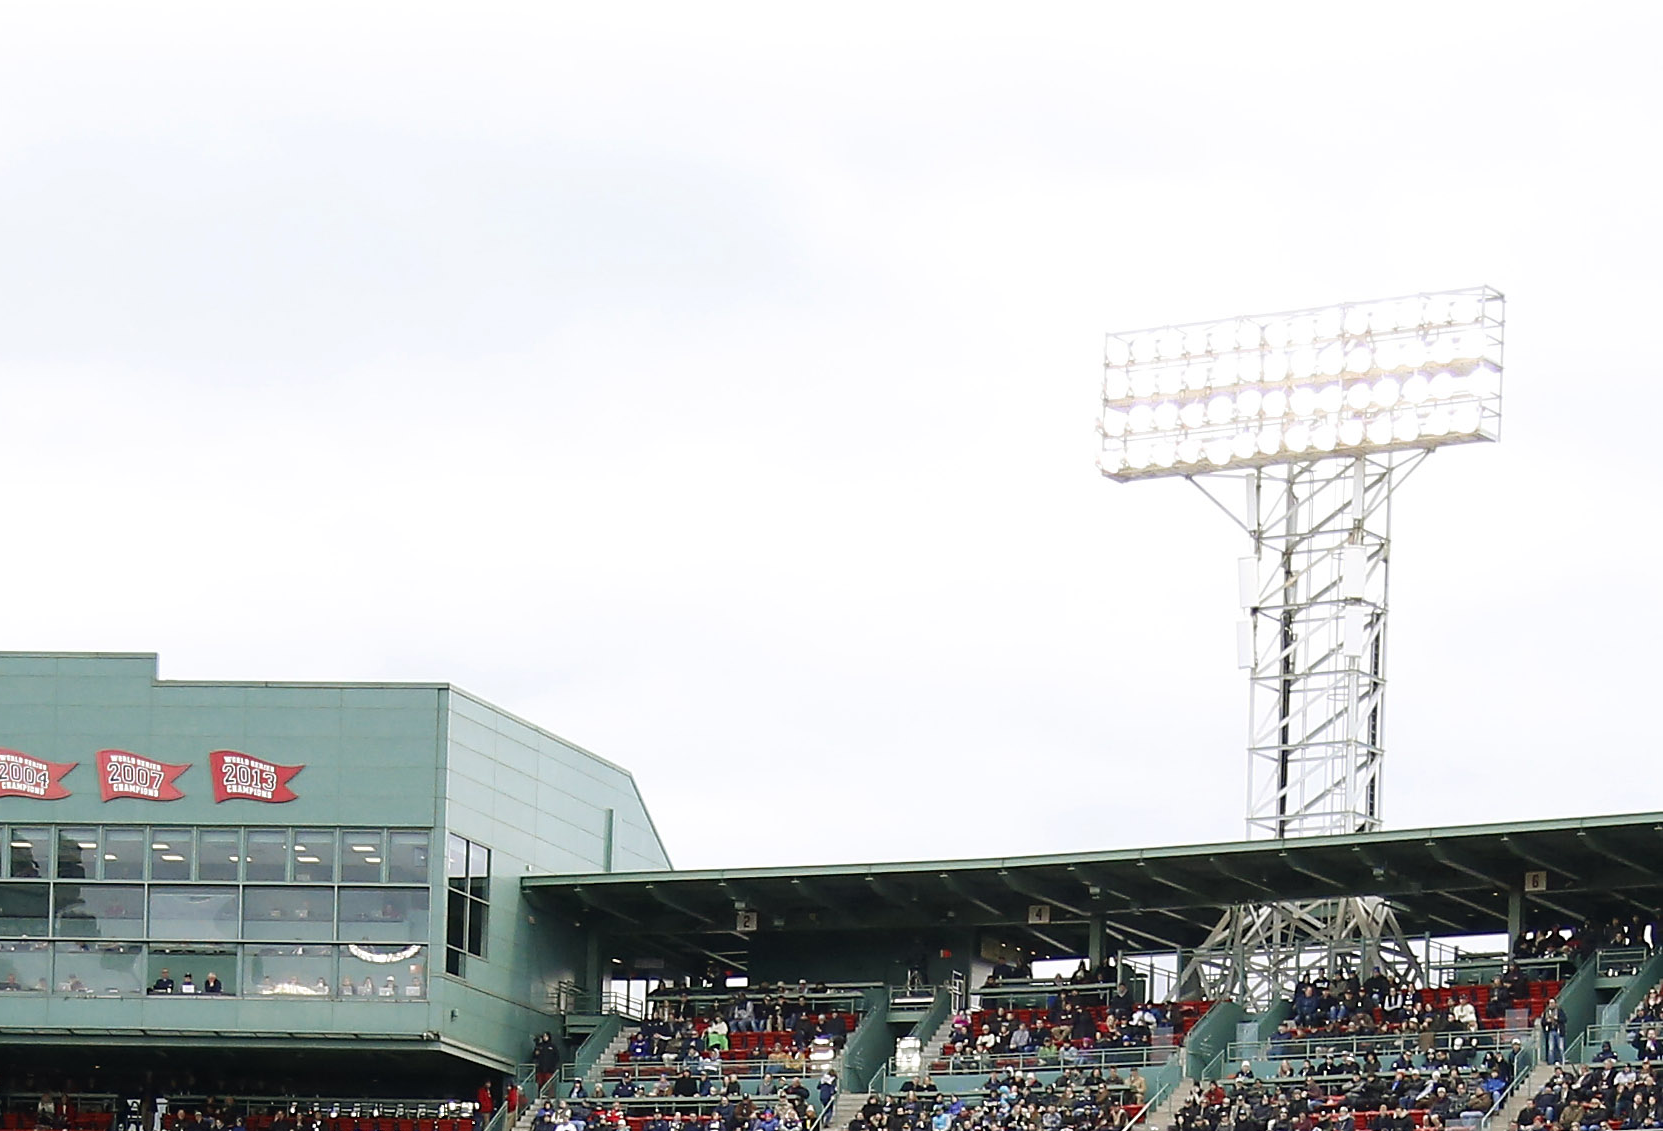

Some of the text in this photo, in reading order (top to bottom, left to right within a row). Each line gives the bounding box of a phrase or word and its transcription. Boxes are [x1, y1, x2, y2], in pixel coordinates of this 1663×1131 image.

[24, 758, 47, 771] SERIES
[110, 754, 161, 771] WORLD SERIES
[223, 755, 275, 773] WORLD SERIES
[107, 762, 164, 790] 2007
[222, 764, 276, 792] 2013
[1, 781, 45, 796] CHAMPIONS
[113, 783, 159, 798] CHAMPIONS
[226, 784, 272, 799] CHAMPIONS
[743, 914, 750, 928] 2
